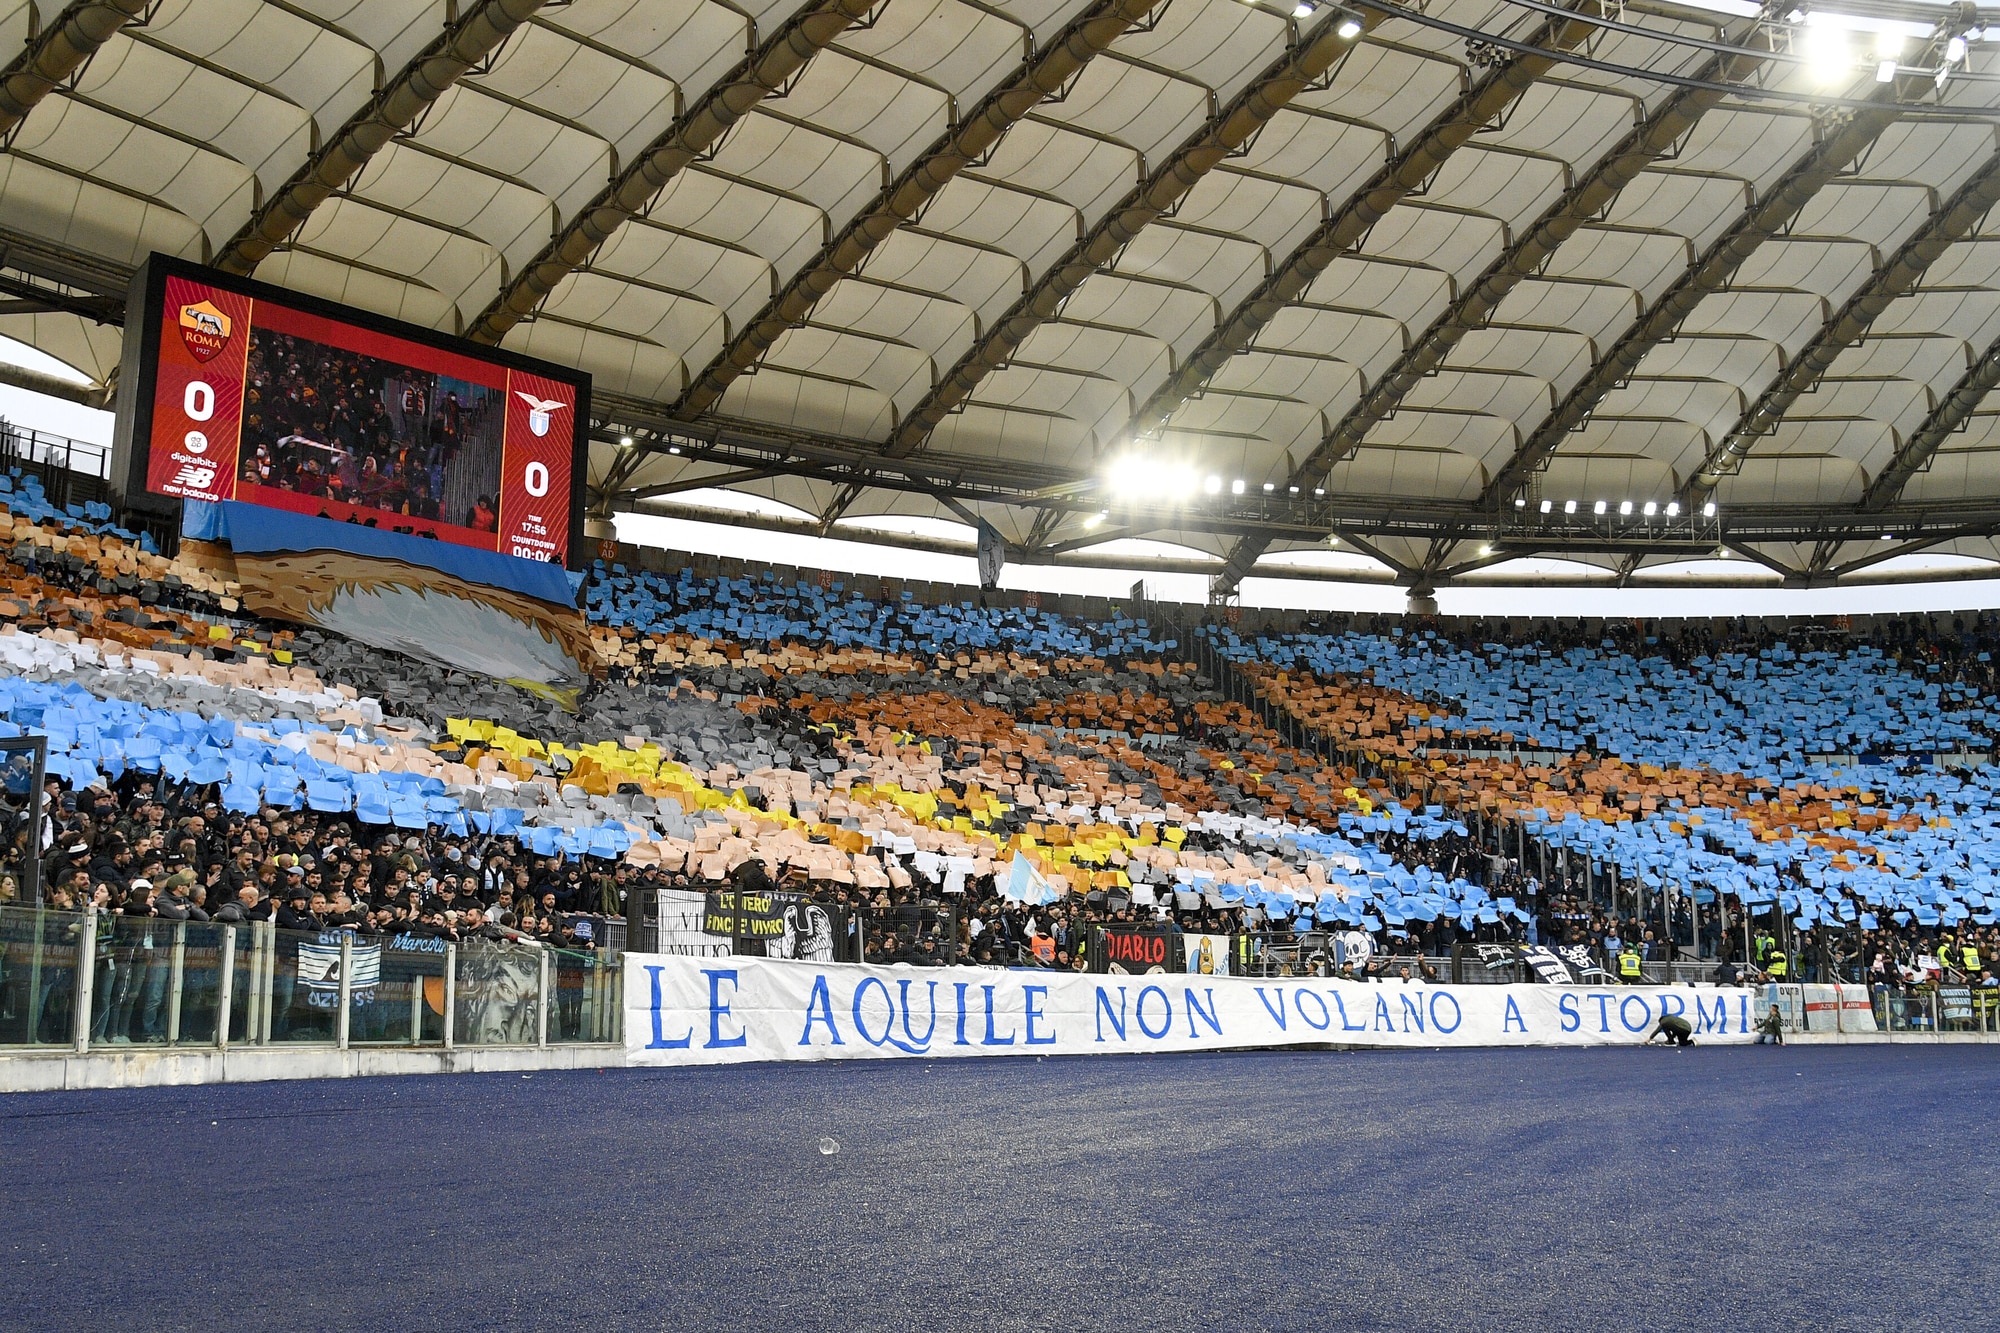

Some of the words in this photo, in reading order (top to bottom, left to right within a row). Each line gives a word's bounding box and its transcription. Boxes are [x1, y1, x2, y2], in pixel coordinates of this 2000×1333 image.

[185, 331, 222, 349] ROMA
[196, 347, 210, 355] 1927
[183, 380, 216, 422] 0
[171, 452, 218, 468] digitalbits
[524, 461, 549, 498] 0
[163, 484, 182, 494] new
[183, 487, 219, 501] balance
[528, 514, 542, 523] TIME
[522, 522, 547, 535] 17:56
[511, 535, 556, 550] COUNTDOWN
[603, 541, 614, 549] 47
[601, 550, 615, 559] AD
[1107, 933, 1166, 963] DIABLO
[643, 965, 748, 1051] LE
[797, 973, 1058, 1055] AQUILE
[1094, 985, 1224, 1041] NON
[1253, 986, 1463, 1035] VOLANO
[1502, 993, 1529, 1034] A
